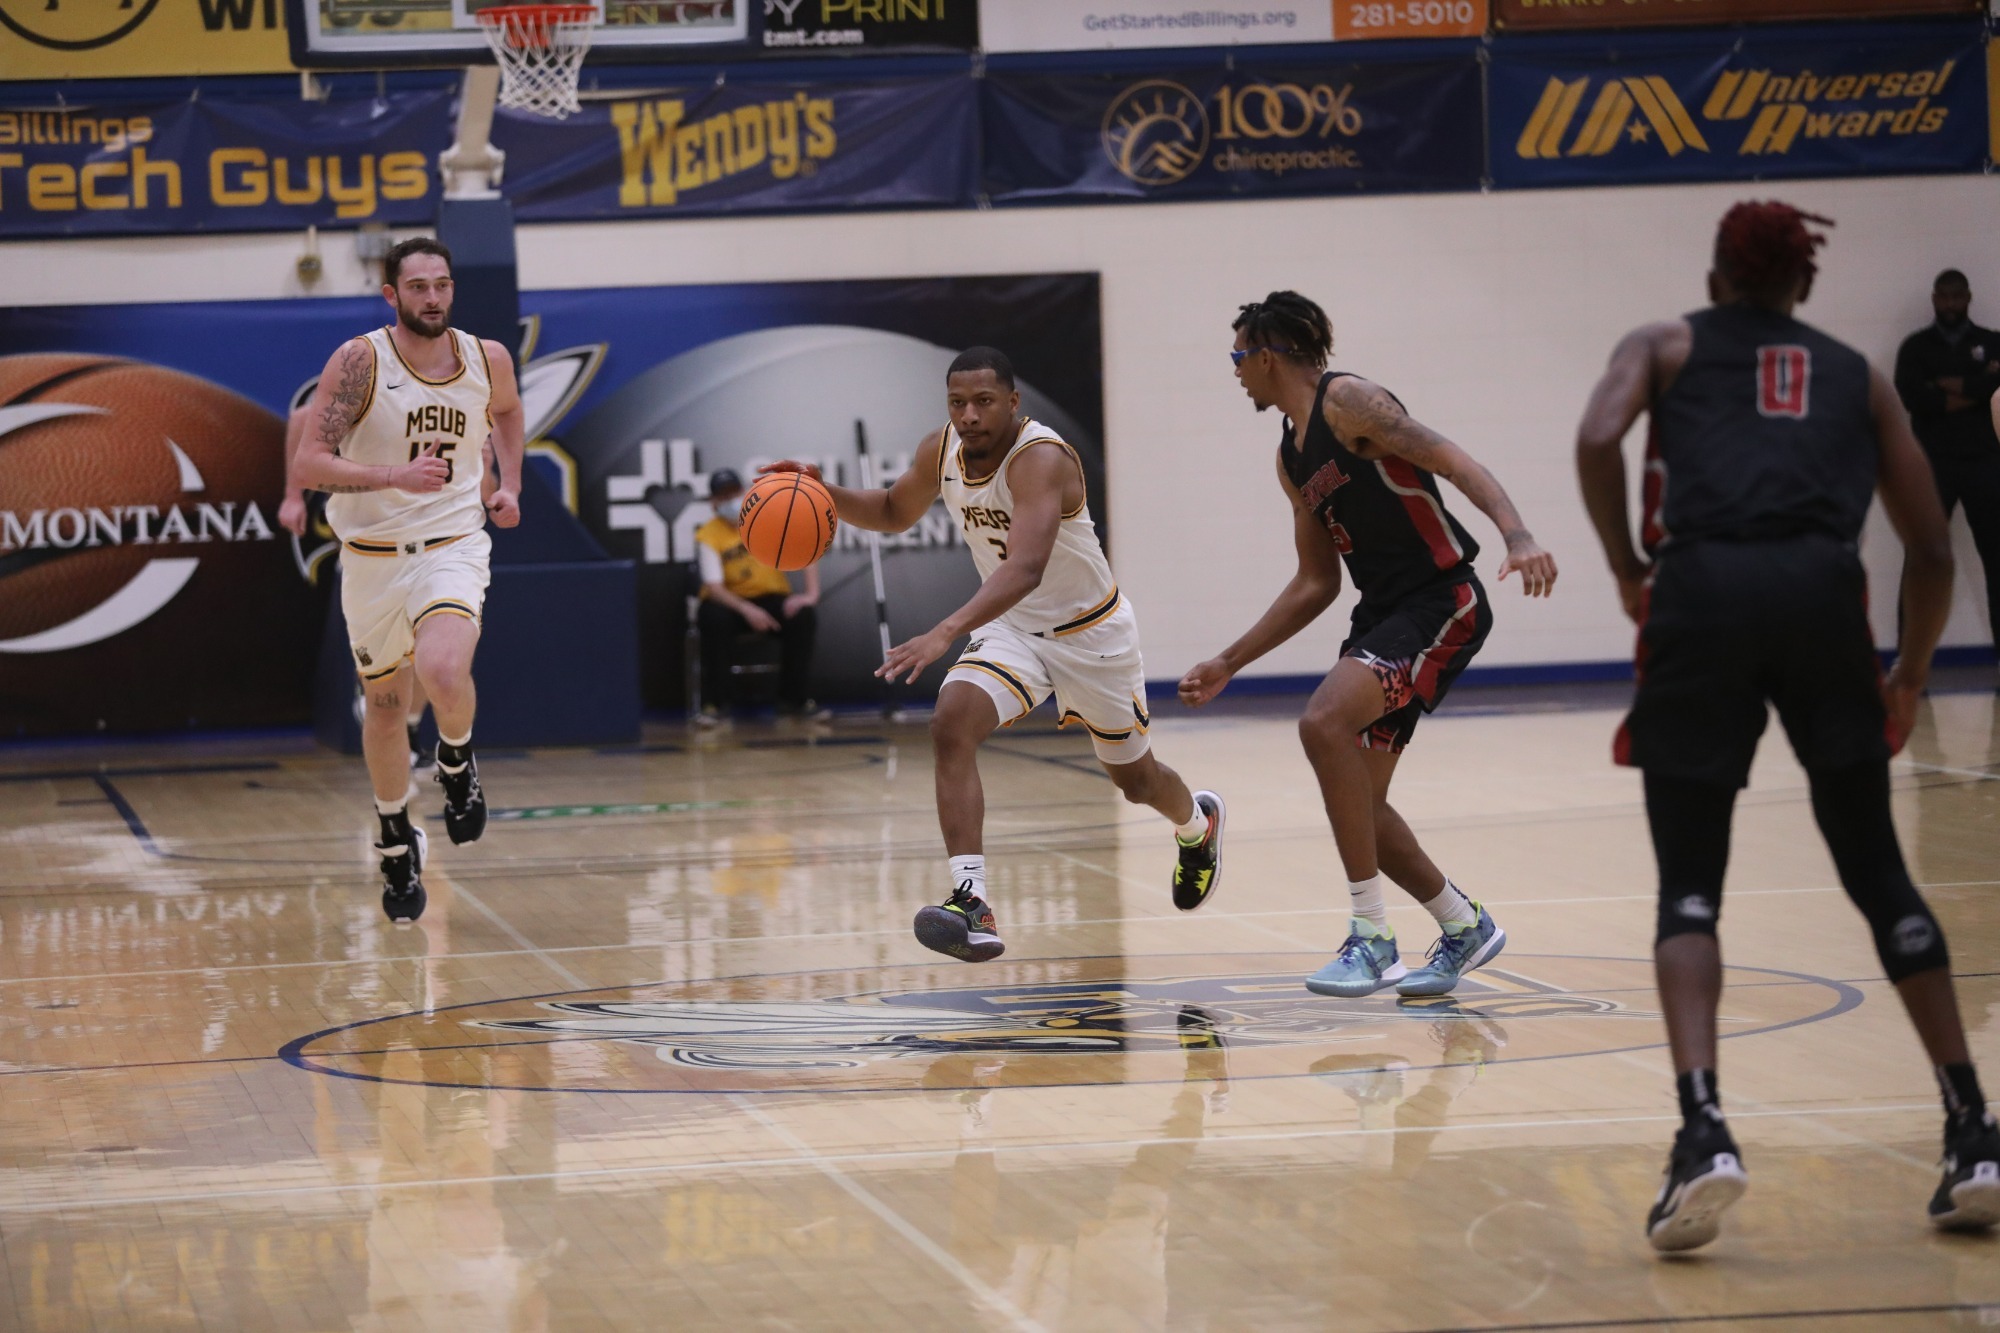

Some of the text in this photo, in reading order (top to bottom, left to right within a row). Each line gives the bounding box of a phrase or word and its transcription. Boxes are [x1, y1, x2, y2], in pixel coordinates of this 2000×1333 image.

[1082, 9, 1297, 31] GetStartedBillings.org
[1349, 0, 1475, 29] 281-5010
[1213, 81, 1363, 139] 100%
[1702, 58, 1957, 121] Universal
[0, 112, 154, 153] Billings
[1737, 98, 1949, 156] Awards
[209, 147, 429, 220] Guys
[405, 405, 466, 439] MSUB
[0, 500, 275, 550] MONTANA
